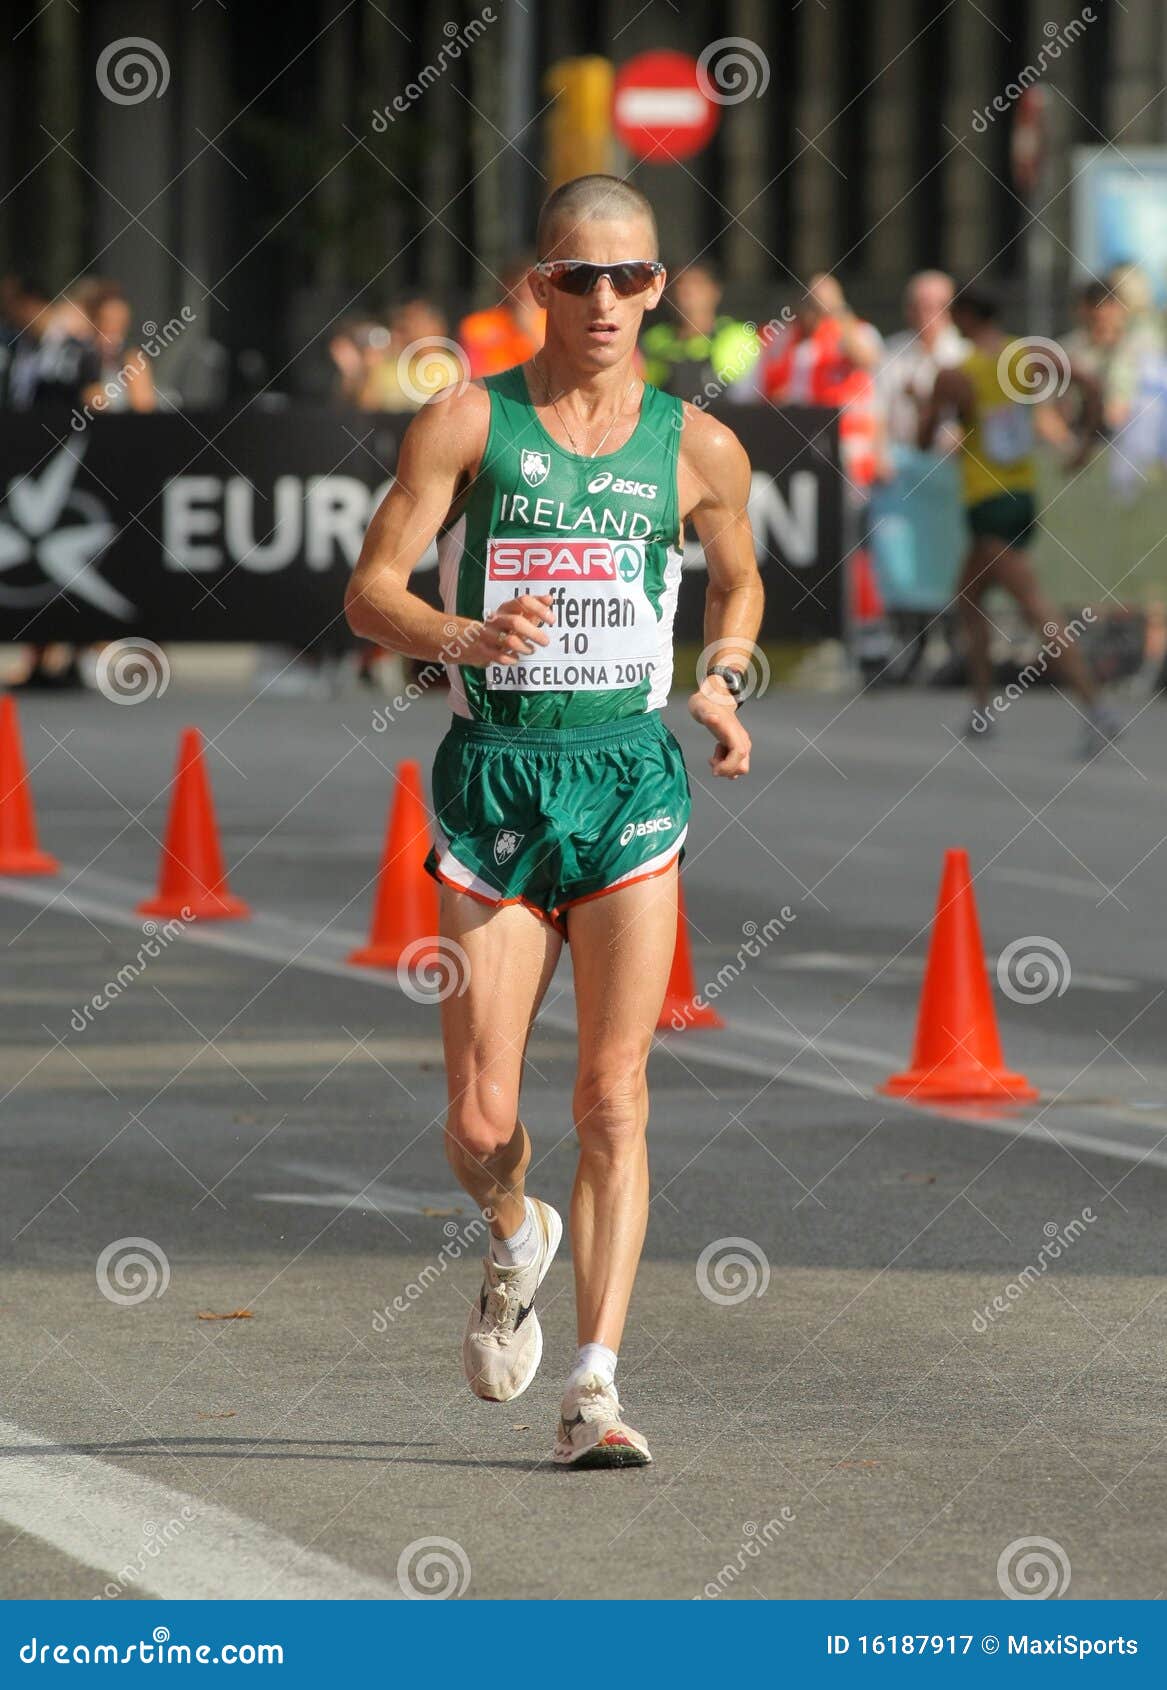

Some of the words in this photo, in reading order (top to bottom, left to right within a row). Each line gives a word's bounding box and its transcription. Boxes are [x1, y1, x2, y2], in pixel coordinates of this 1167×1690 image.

[611, 478, 658, 500] asics
[500, 494, 653, 540] IRELAND
[493, 547, 614, 577] SPAR
[514, 587, 636, 629] ffernan
[559, 632, 589, 655] 10
[492, 665, 608, 686] BARCELONA
[636, 816, 673, 837] asics
